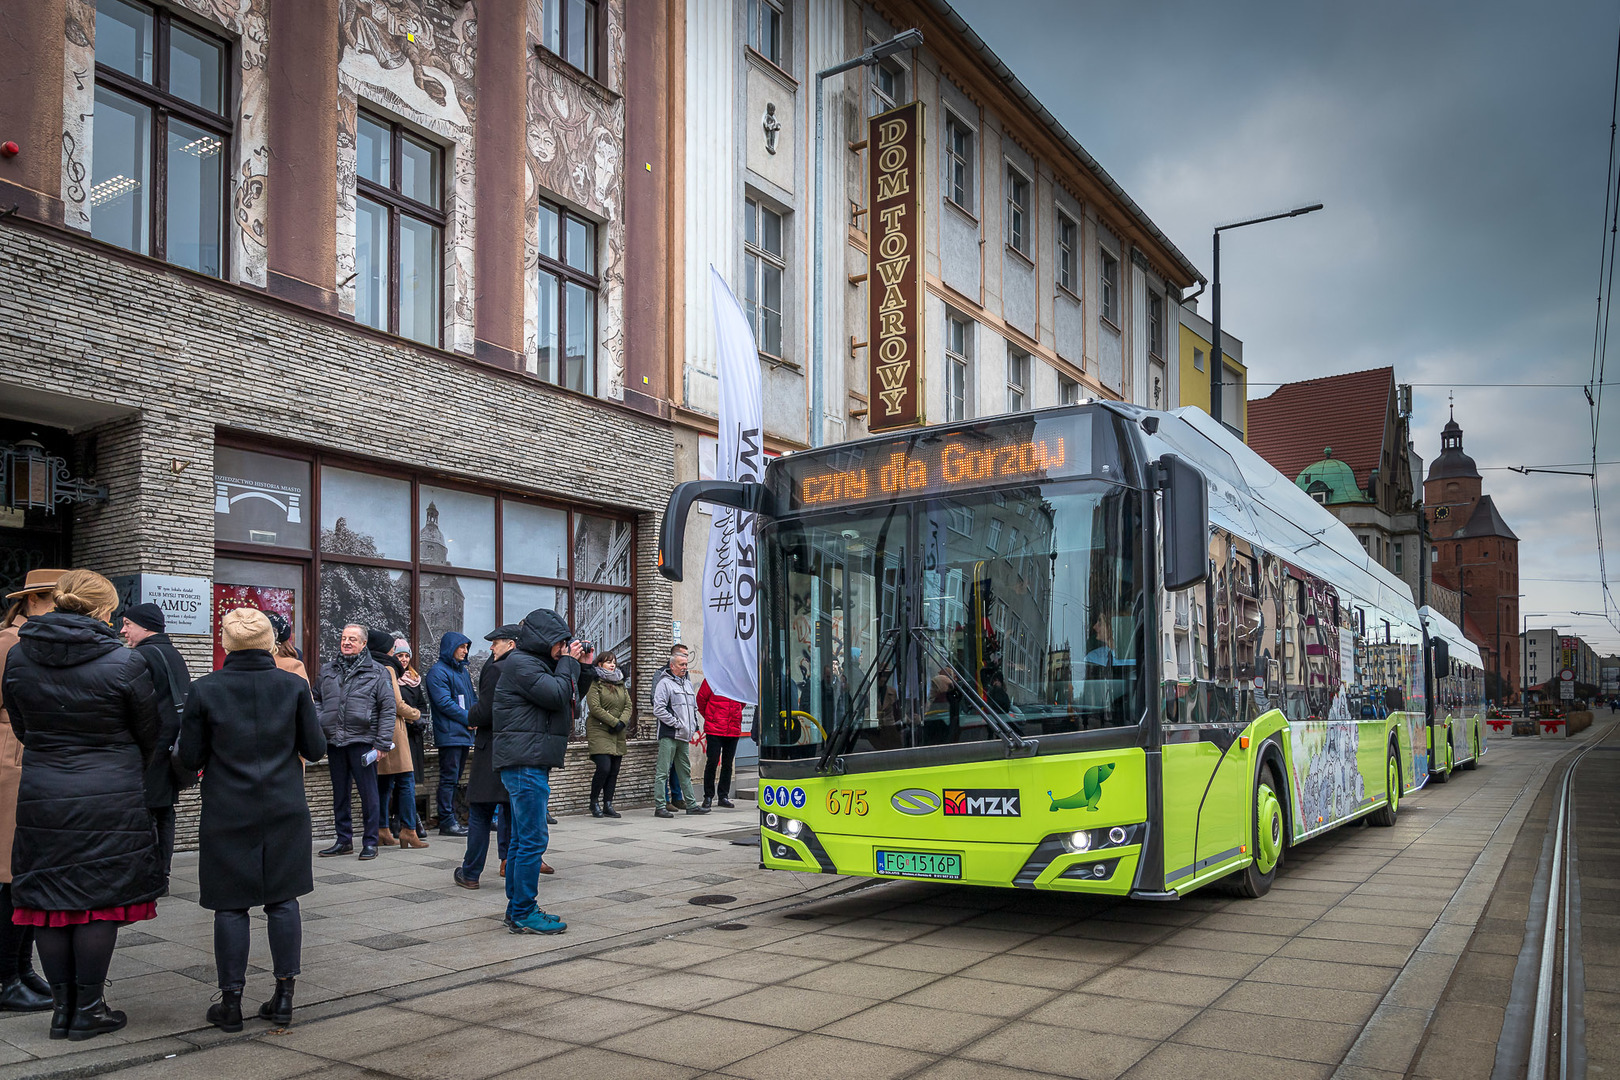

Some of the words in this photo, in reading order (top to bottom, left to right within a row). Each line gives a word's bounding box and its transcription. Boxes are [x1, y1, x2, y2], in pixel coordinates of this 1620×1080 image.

[877, 118, 909, 202] DOM
[876, 203, 911, 416] TOWAROWY
[214, 475, 254, 486] DZIEDZICTWO
[254, 481, 280, 490] HISTORIA
[803, 468, 867, 503] czny
[880, 452, 927, 492] dla
[826, 788, 869, 816] 675
[967, 796, 1019, 815] MZK
[887, 854, 905, 870] FG
[911, 855, 956, 873] 1516P
